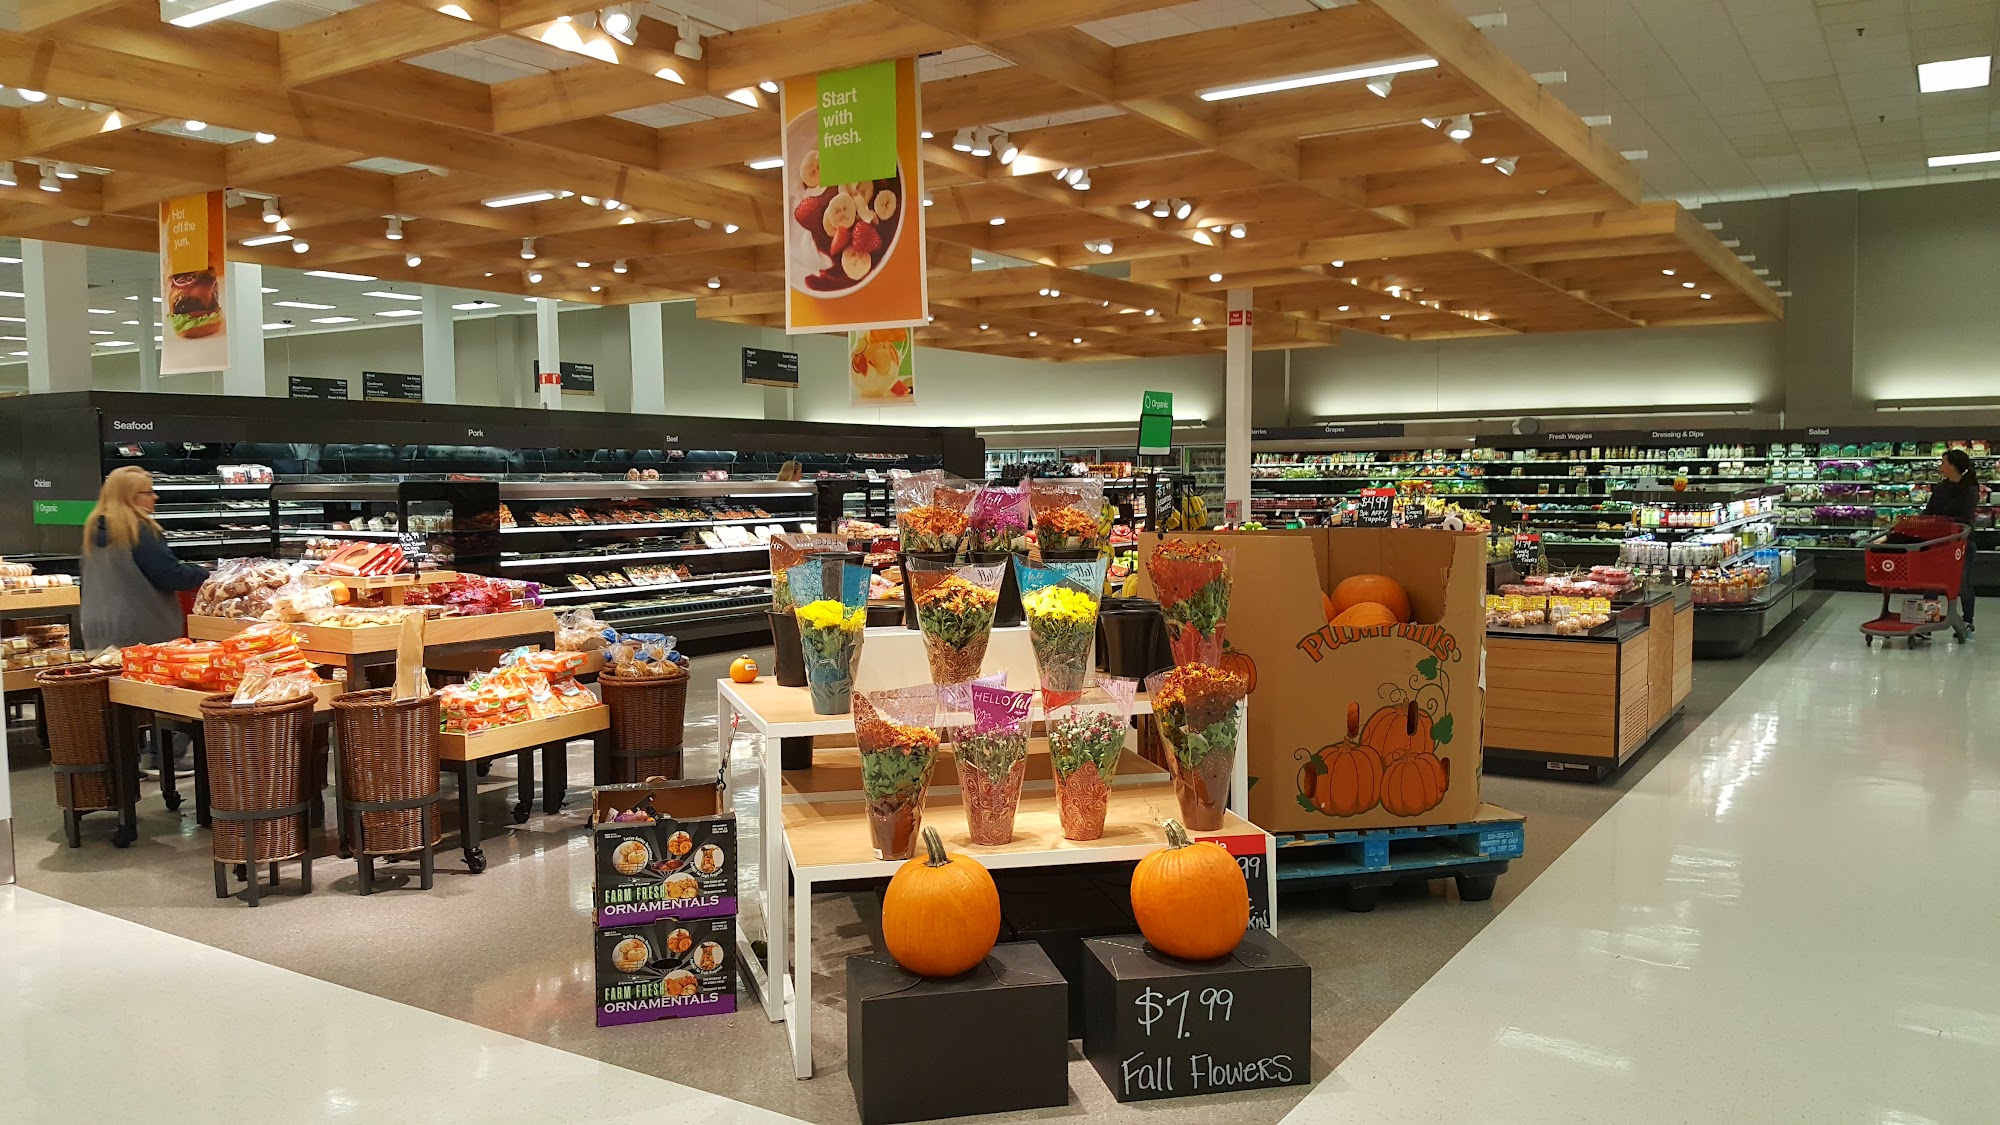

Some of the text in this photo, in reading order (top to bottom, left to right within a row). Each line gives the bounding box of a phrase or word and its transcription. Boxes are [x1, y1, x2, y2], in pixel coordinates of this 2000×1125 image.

[822, 88, 857, 108] Start
[823, 109, 853, 128] with
[824, 128, 861, 148] fresh.
[172, 209, 185, 220] Hot
[183, 220, 196, 232] the
[173, 237, 190, 250] yum.
[1151, 399, 1169, 410] Organic
[113, 420, 154, 431] Seafood
[1325, 426, 1345, 434] Grapes
[468, 428, 485, 437] Pork
[1567, 432, 1593, 441] Veggies
[1652, 431, 1681, 439] Dressing
[1688, 430, 1704, 438] Dips
[1808, 428, 1830, 436] Salad
[666, 435, 679, 443] Beef
[33, 478, 52, 488] Chicken
[39, 503, 58, 514] Organic
[1360, 495, 1388, 510] $4.99
[973, 691, 1011, 707] HELLO
[605, 884, 666, 904] FARM FRESH
[604, 895, 720, 916] ORNAMENTALS
[604, 982, 665, 1002] FARM FRESH
[604, 992, 719, 1013] ORNAMENTALS
[1121, 1051, 1174, 1095] Fall
